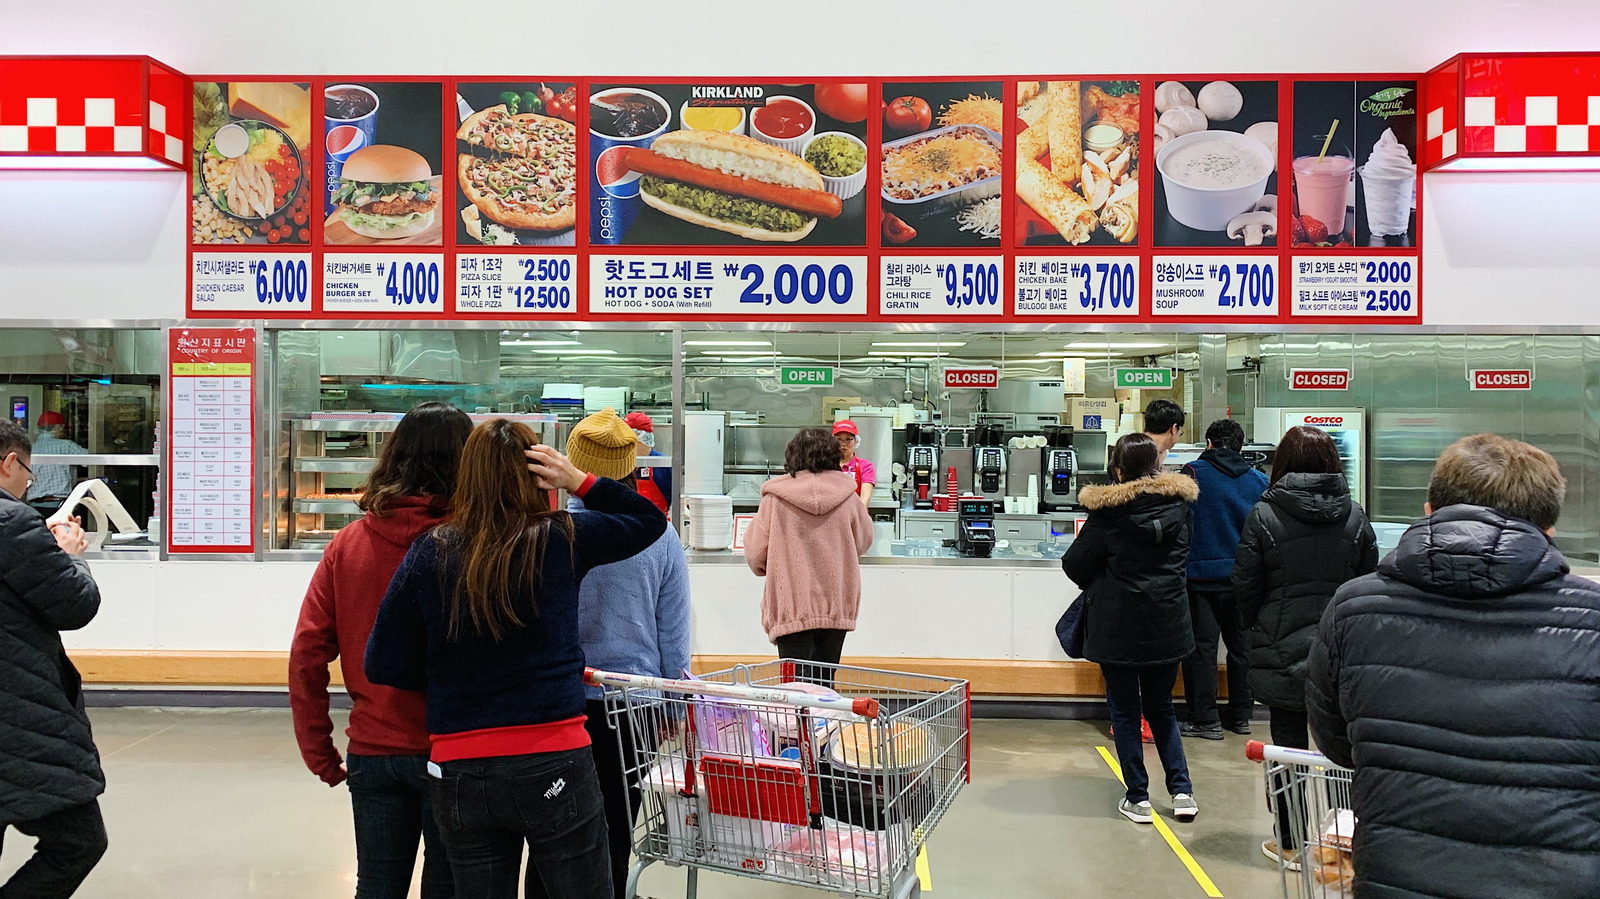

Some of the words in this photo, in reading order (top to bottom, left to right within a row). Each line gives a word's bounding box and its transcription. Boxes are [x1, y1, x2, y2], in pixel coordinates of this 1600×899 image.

[692, 86, 764, 98] KIRKLAND
[1360, 100, 1403, 116] Organic
[326, 161, 336, 192] pepsi
[598, 196, 614, 239] pepsi
[196, 261, 244, 274] 치킨시저샐러드
[327, 263, 371, 274] 치킨버거세트
[461, 258, 477, 271] 피자
[482, 258, 502, 271] 1조각
[605, 260, 714, 281] 핫도그세트
[887, 264, 902, 275] 칠리
[906, 264, 931, 275] 라이스
[1019, 262, 1036, 275] 치킨
[1042, 262, 1068, 275] 베이크
[1156, 263, 1204, 282] 양송이스프
[886, 276, 911, 287] 그라탕
[196, 284, 220, 292] CHICKEN
[222, 284, 244, 292] CAESAR
[461, 285, 481, 298] 피자
[605, 286, 637, 298] HOT
[645, 287, 677, 298] DOG
[683, 287, 713, 298] SET
[1156, 289, 1204, 297] MUSHROOM
[1018, 288, 1040, 301] 불고기
[1045, 288, 1067, 301] 베이크
[1156, 300, 1178, 308] SOUP
[788, 371, 826, 382] OPEN
[946, 373, 996, 384] CLOSED
[1124, 372, 1163, 382] OPEN
[1295, 374, 1346, 386] CLOSED
[1477, 374, 1528, 384] CLOSED
